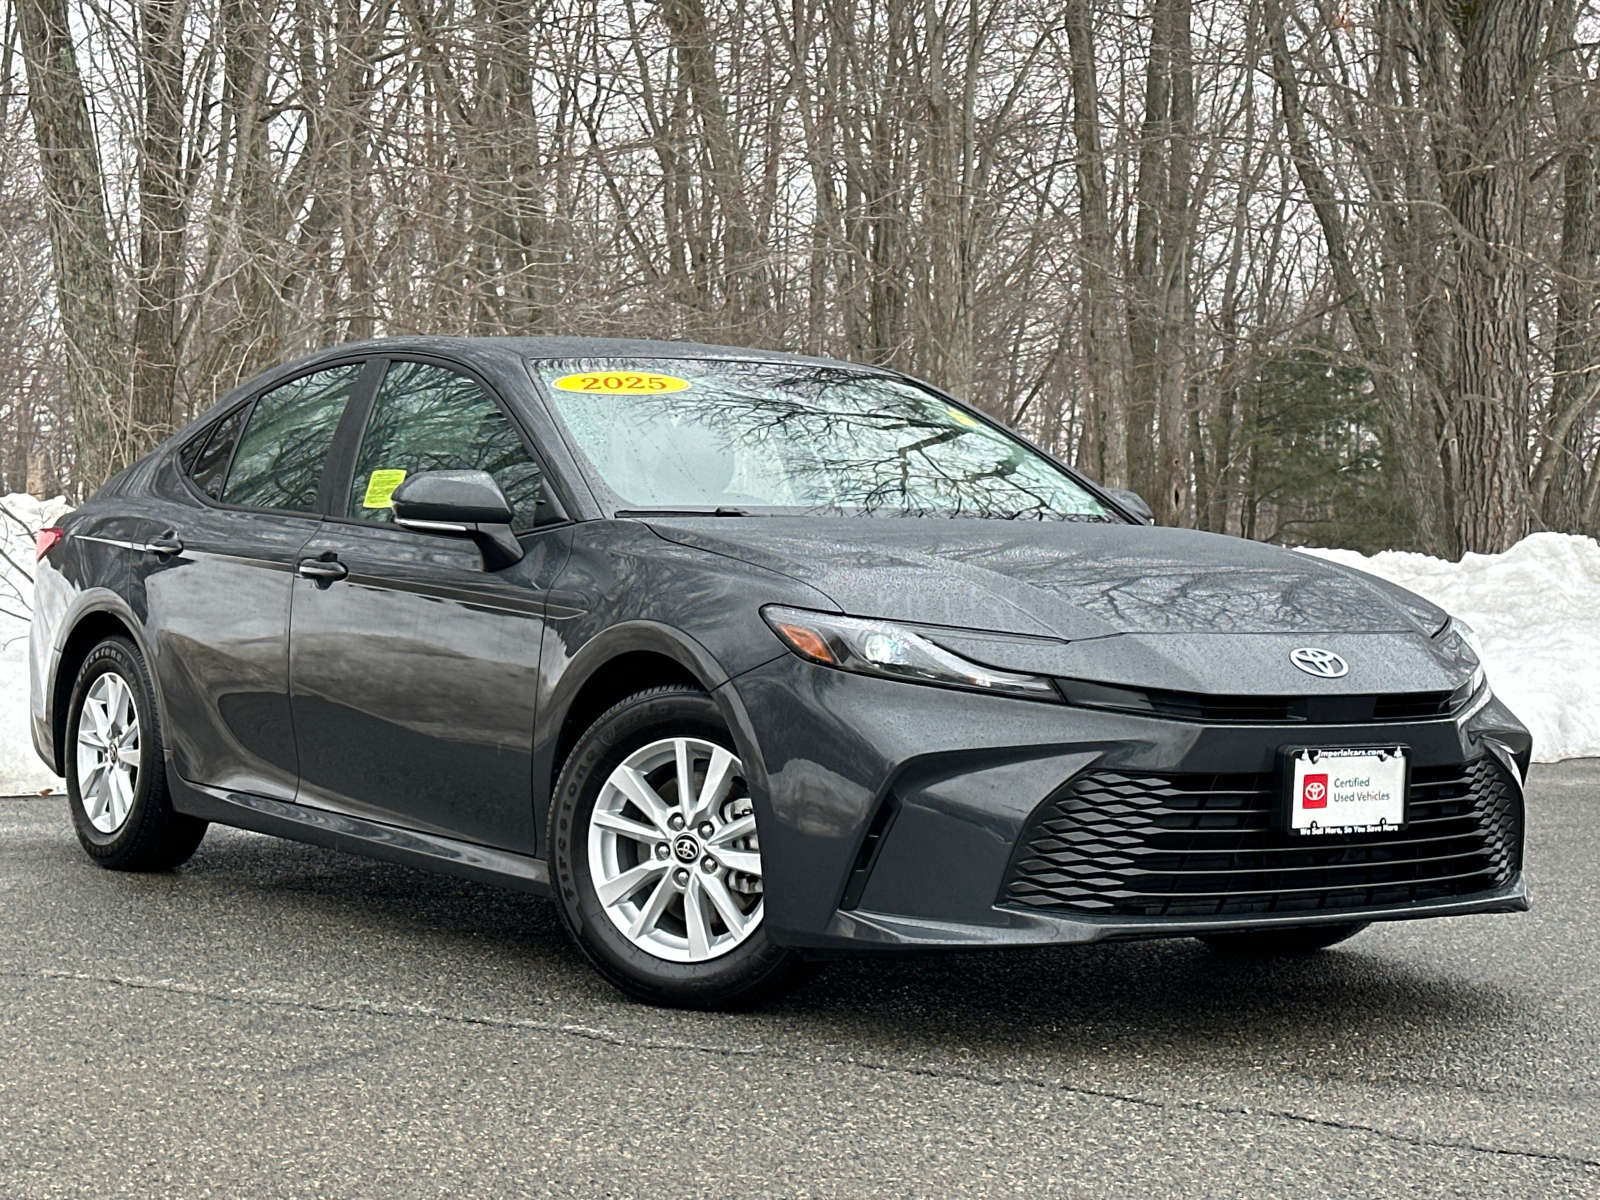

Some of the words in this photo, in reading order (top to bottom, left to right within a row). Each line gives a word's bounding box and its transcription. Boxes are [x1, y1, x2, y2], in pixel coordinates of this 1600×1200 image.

[581, 376, 667, 390] 2025
[1334, 777, 1370, 788] Certified
[1333, 792, 1355, 802] Used
[1357, 790, 1390, 801] Vehicles
[557, 750, 596, 902] Firestone
[1311, 827, 1324, 835] Sell
[1343, 826, 1353, 834] So
[1353, 825, 1366, 833] You
[1383, 824, 1399, 832] More
